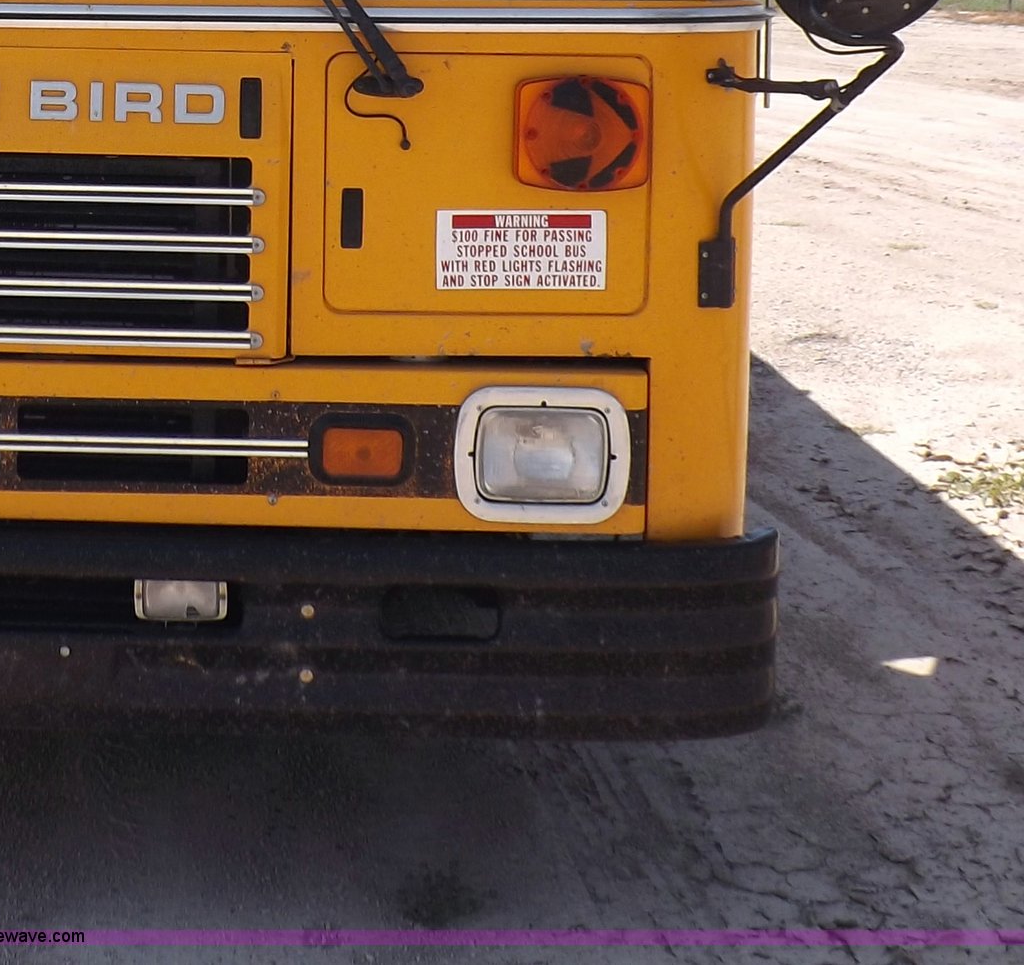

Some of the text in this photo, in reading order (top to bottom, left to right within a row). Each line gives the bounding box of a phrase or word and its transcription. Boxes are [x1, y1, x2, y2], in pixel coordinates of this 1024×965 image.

[29, 80, 226, 125] BIRD
[494, 215, 549, 228] WARNING
[451, 230, 593, 243] $100 FINE FOR PASSING
[457, 245, 587, 258] STOPPED SCHOOL BUS
[441, 260, 603, 272] WITH RED LIGHTS FLASHING
[442, 275, 601, 288] AND STOP SIGN ACTIVATED.
